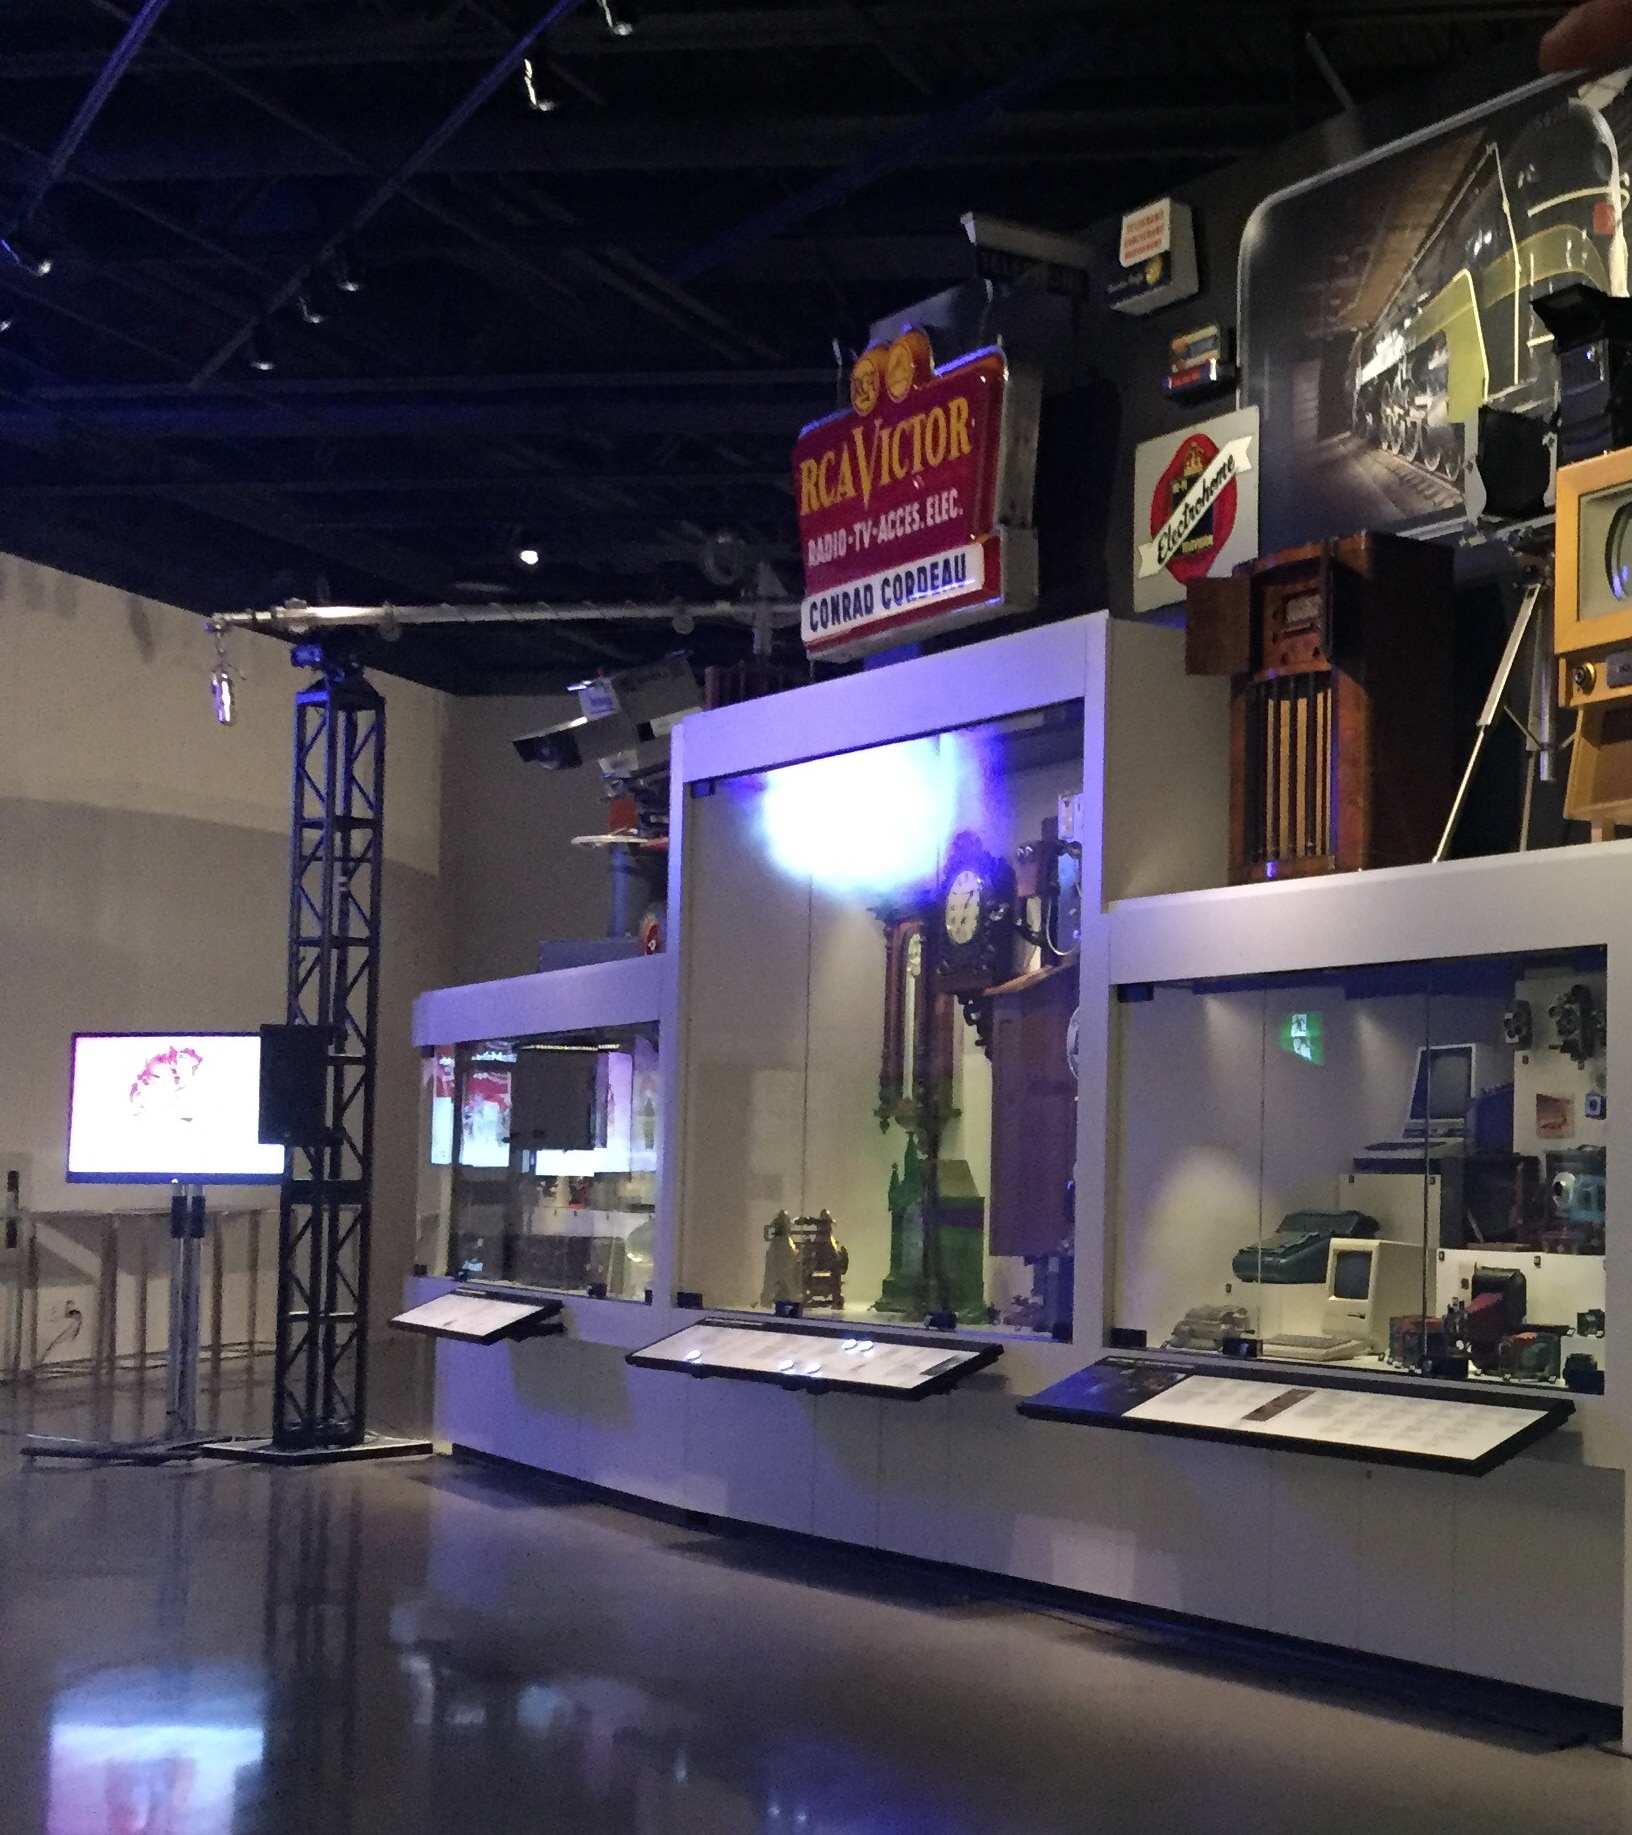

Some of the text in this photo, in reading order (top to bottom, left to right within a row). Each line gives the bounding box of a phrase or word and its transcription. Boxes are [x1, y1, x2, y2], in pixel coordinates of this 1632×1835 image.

[1157, 454, 1235, 565] Electrohome
[810, 553, 966, 632] CONRAD CORDEAU
